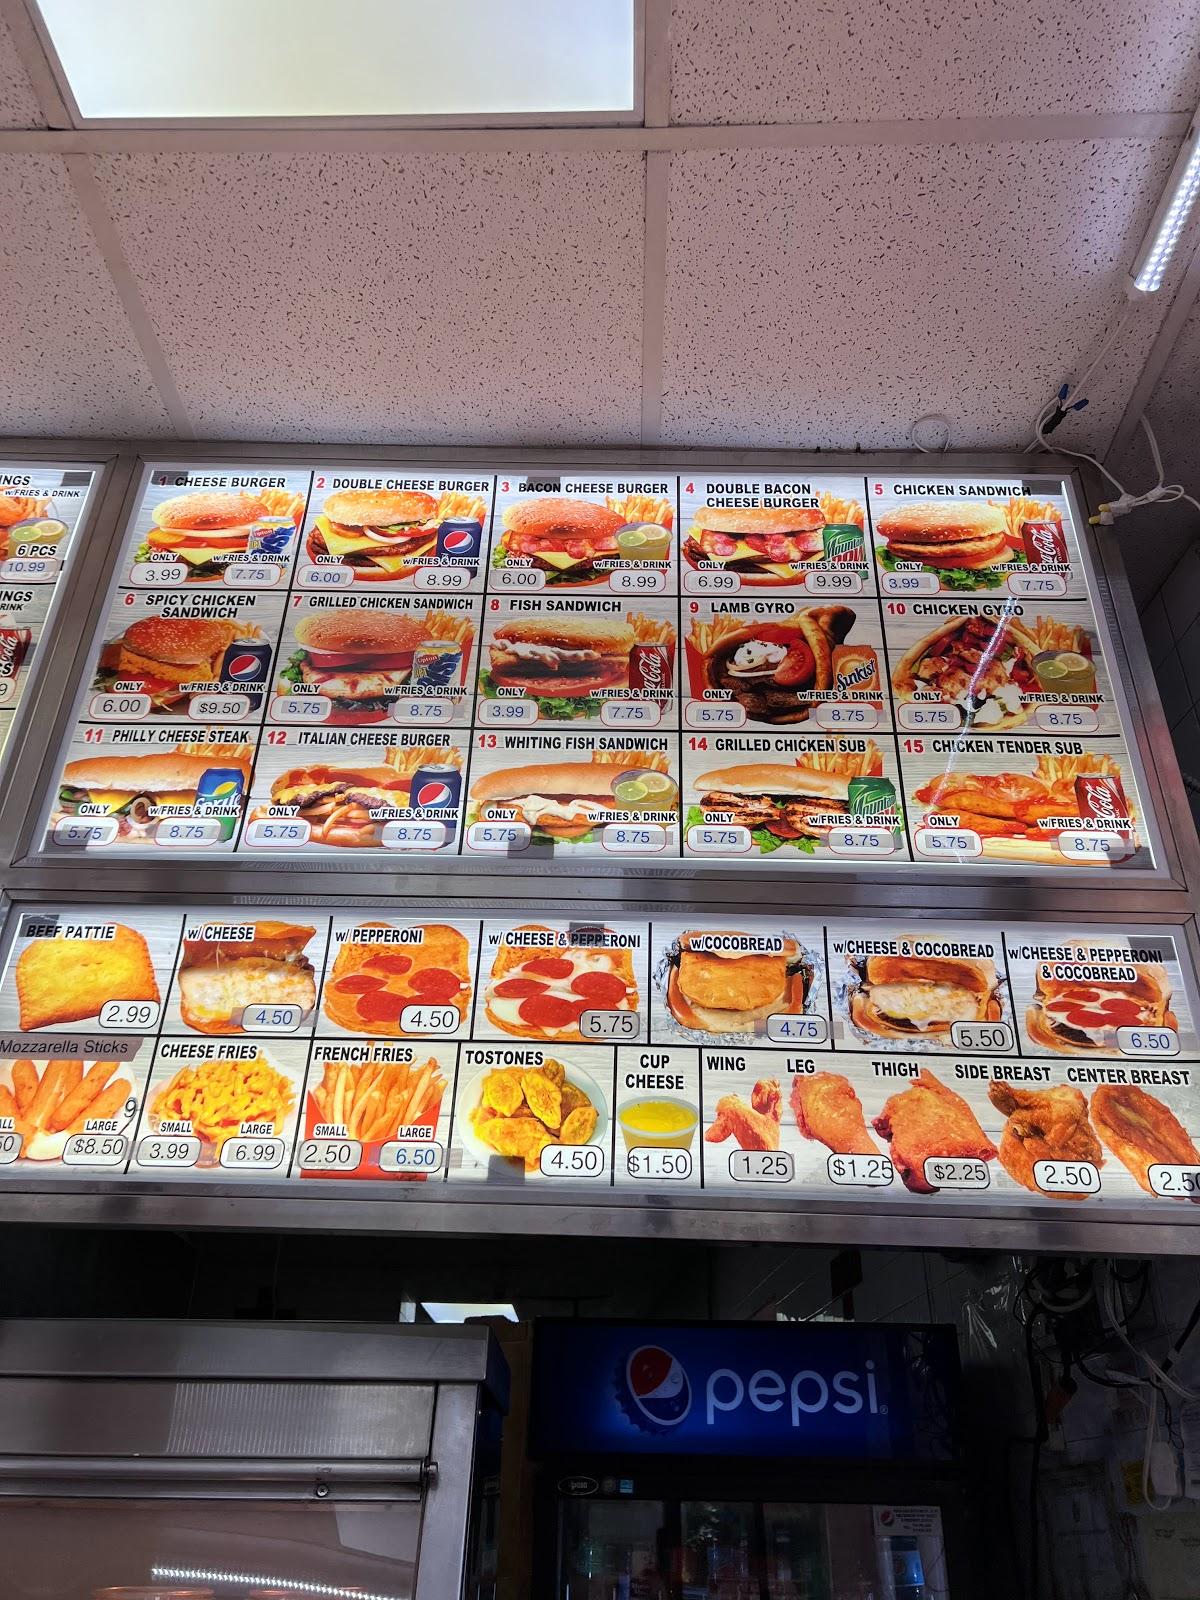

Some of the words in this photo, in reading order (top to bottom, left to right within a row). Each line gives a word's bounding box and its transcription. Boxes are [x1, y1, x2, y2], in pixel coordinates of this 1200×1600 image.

[159, 476, 167, 486] 1
[175, 477, 229, 487] CHEESE
[231, 478, 286, 488] BURGER
[316, 478, 325, 488] 2
[333, 479, 382, 489] DOUBLE
[387, 480, 434, 490] CHEESE
[439, 481, 489, 491] BURGER
[502, 482, 510, 492] 3
[519, 482, 561, 492] BACON
[565, 483, 615, 493] CHEESE
[618, 484, 668, 493] BURGER
[686, 483, 694, 493] 4
[706, 483, 760, 494] DOUBLE
[764, 484, 811, 494] BACON
[875, 484, 883, 495] 5
[894, 485, 955, 495] CHICKEN
[959, 485, 1031, 496] SANDWICH
[706, 498, 759, 508] CHEESE
[764, 498, 819, 508] BURGER
[18, 546, 25, 555] 6
[31, 546, 56, 555] PCS
[153, 554, 177, 562] ONLY
[213, 554, 249, 562] w/FRIES
[250, 554, 257, 562] &
[258, 554, 290, 562] DRINK
[8, 562, 45, 572] 10.99
[145, 569, 181, 581] 3.99
[235, 569, 265, 579] 7.75
[502, 573, 537, 585] 6.00
[622, 576, 657, 587] 8.99
[699, 576, 733, 588] 6.99
[889, 578, 919, 588] 3.99
[1023, 581, 1054, 591] 7.75
[125, 594, 134, 605] 6
[146, 594, 189, 605] SPICY
[192, 595, 256, 606] CHICKEN
[293, 596, 302, 607] 7
[309, 597, 357, 607] GRILLED
[360, 597, 410, 608] CHICKEN
[413, 598, 473, 609] SANDWICH
[490, 600, 500, 610] 8
[510, 600, 541, 610] FISH
[546, 601, 621, 612] SANDWICH
[161, 608, 238, 618] SANDWICH
[690, 602, 699, 613] 9
[711, 602, 750, 613] LAMB
[755, 603, 795, 613] GYRO
[887, 604, 905, 614] 10
[913, 604, 978, 615] CHICKEN
[836, 659, 875, 691] Sunkist
[103, 700, 140, 712] 6.00
[199, 702, 240, 714] $9.50
[492, 706, 524, 717] 3.99
[914, 712, 947, 722] 5.75
[1049, 713, 1083, 725] 8.75
[84, 729, 104, 742] 11
[112, 730, 155, 742] PHILLY
[159, 730, 205, 742] CHEESE
[209, 731, 249, 743] STEAK
[268, 731, 287, 744] 12
[299, 732, 346, 745] ITALIAN
[350, 733, 397, 745] CHEESE
[401, 734, 450, 746] BURGER
[479, 735, 497, 747] 13
[505, 736, 561, 748] WHITING
[566, 737, 595, 749] FISH
[599, 738, 668, 750] SANDWICH
[689, 738, 708, 750] 14
[715, 739, 770, 751] GRILLED
[775, 739, 834, 752] CHICKEN
[839, 740, 865, 752] SUB
[903, 740, 924, 753] 15
[933, 740, 994, 753] CHICKEN
[1000, 741, 1051, 753] TENDER
[1056, 742, 1082, 754] SUB
[80, 806, 109, 814] ONLY
[150, 806, 191, 815] w/FRIES
[194, 807, 201, 815] &
[205, 807, 239, 815] DRINK
[705, 814, 734, 822] ONLY
[809, 815, 852, 824] w/FRIES
[855, 815, 863, 824] &
[866, 816, 900, 825] DRINK
[68, 827, 102, 839] 5.75
[170, 826, 204, 838] 8.75
[483, 829, 517, 841] 5.75
[704, 832, 737, 843] 5.75
[844, 834, 879, 846] 8.75
[932, 836, 967, 848] 5.75
[26, 925, 62, 937] BEEF
[65, 926, 115, 938] PATTIE
[188, 927, 202, 940] w/
[204, 927, 254, 940] CHEESE
[335, 929, 349, 942] w/
[352, 929, 422, 943] PEPPERONI
[489, 932, 502, 945] w/
[506, 933, 554, 945] CHEESE
[558, 934, 567, 945] &
[571, 934, 640, 947] PEPPERONI
[692, 936, 782, 951] w/COCOBREAD
[833, 940, 897, 955] w/CHEESE
[902, 942, 911, 955] &
[915, 942, 994, 957] COCOBREAD
[1008, 946, 1073, 960] w/CHEESE
[1077, 948, 1086, 961] &
[1091, 948, 1162, 963] PEPPERONI
[1042, 965, 1051, 978] &
[1055, 966, 1135, 980] COCOBREAD
[107, 1005, 151, 1023] 2.99
[256, 1010, 292, 1025] 4.50
[411, 1011, 454, 1027] 4.50
[590, 1016, 632, 1033] 5.75
[780, 1022, 818, 1036] 4.75
[961, 1029, 1005, 1047] 5.50
[1131, 1033, 1170, 1049] 6.50
[0, 1040, 78, 1053] Mozzarella
[84, 1039, 128, 1053] Sticks
[161, 1044, 214, 1058] CHEESE
[218, 1045, 258, 1059] FRIES
[314, 1047, 369, 1061] FRENCH
[373, 1048, 413, 1061] FRIES
[466, 1051, 544, 1066] TOSTONES
[640, 1054, 670, 1069] CUP
[707, 1056, 746, 1071] WING
[787, 1059, 815, 1073] LEG
[872, 1062, 919, 1077] THIGH
[955, 1064, 988, 1079] SIDE
[993, 1065, 1051, 1081] BREAST
[625, 1074, 684, 1089] CHEESE
[1067, 1068, 1128, 1083] CENTER
[1132, 1070, 1190, 1085] BREAST
[86, 1121, 118, 1131] LARGE
[160, 1122, 192, 1132] SMALL
[240, 1124, 273, 1134] LARGE
[315, 1126, 346, 1136] SMALL
[400, 1128, 431, 1137] LARGE
[74, 1138, 123, 1155] $8.50
[150, 1143, 189, 1159] 3.99
[235, 1144, 275, 1161] 6.99
[304, 1145, 350, 1163] 2.50
[396, 1148, 435, 1165] 6.50
[551, 1151, 597, 1170] 4.50
[627, 1155, 688, 1173] $1.50
[742, 1156, 787, 1175] 1.25
[833, 1158, 894, 1179] $1.25
[934, 1164, 986, 1181] $2.25
[1044, 1165, 1092, 1185] 2.50
[706, 1360, 879, 1426] pepsi
